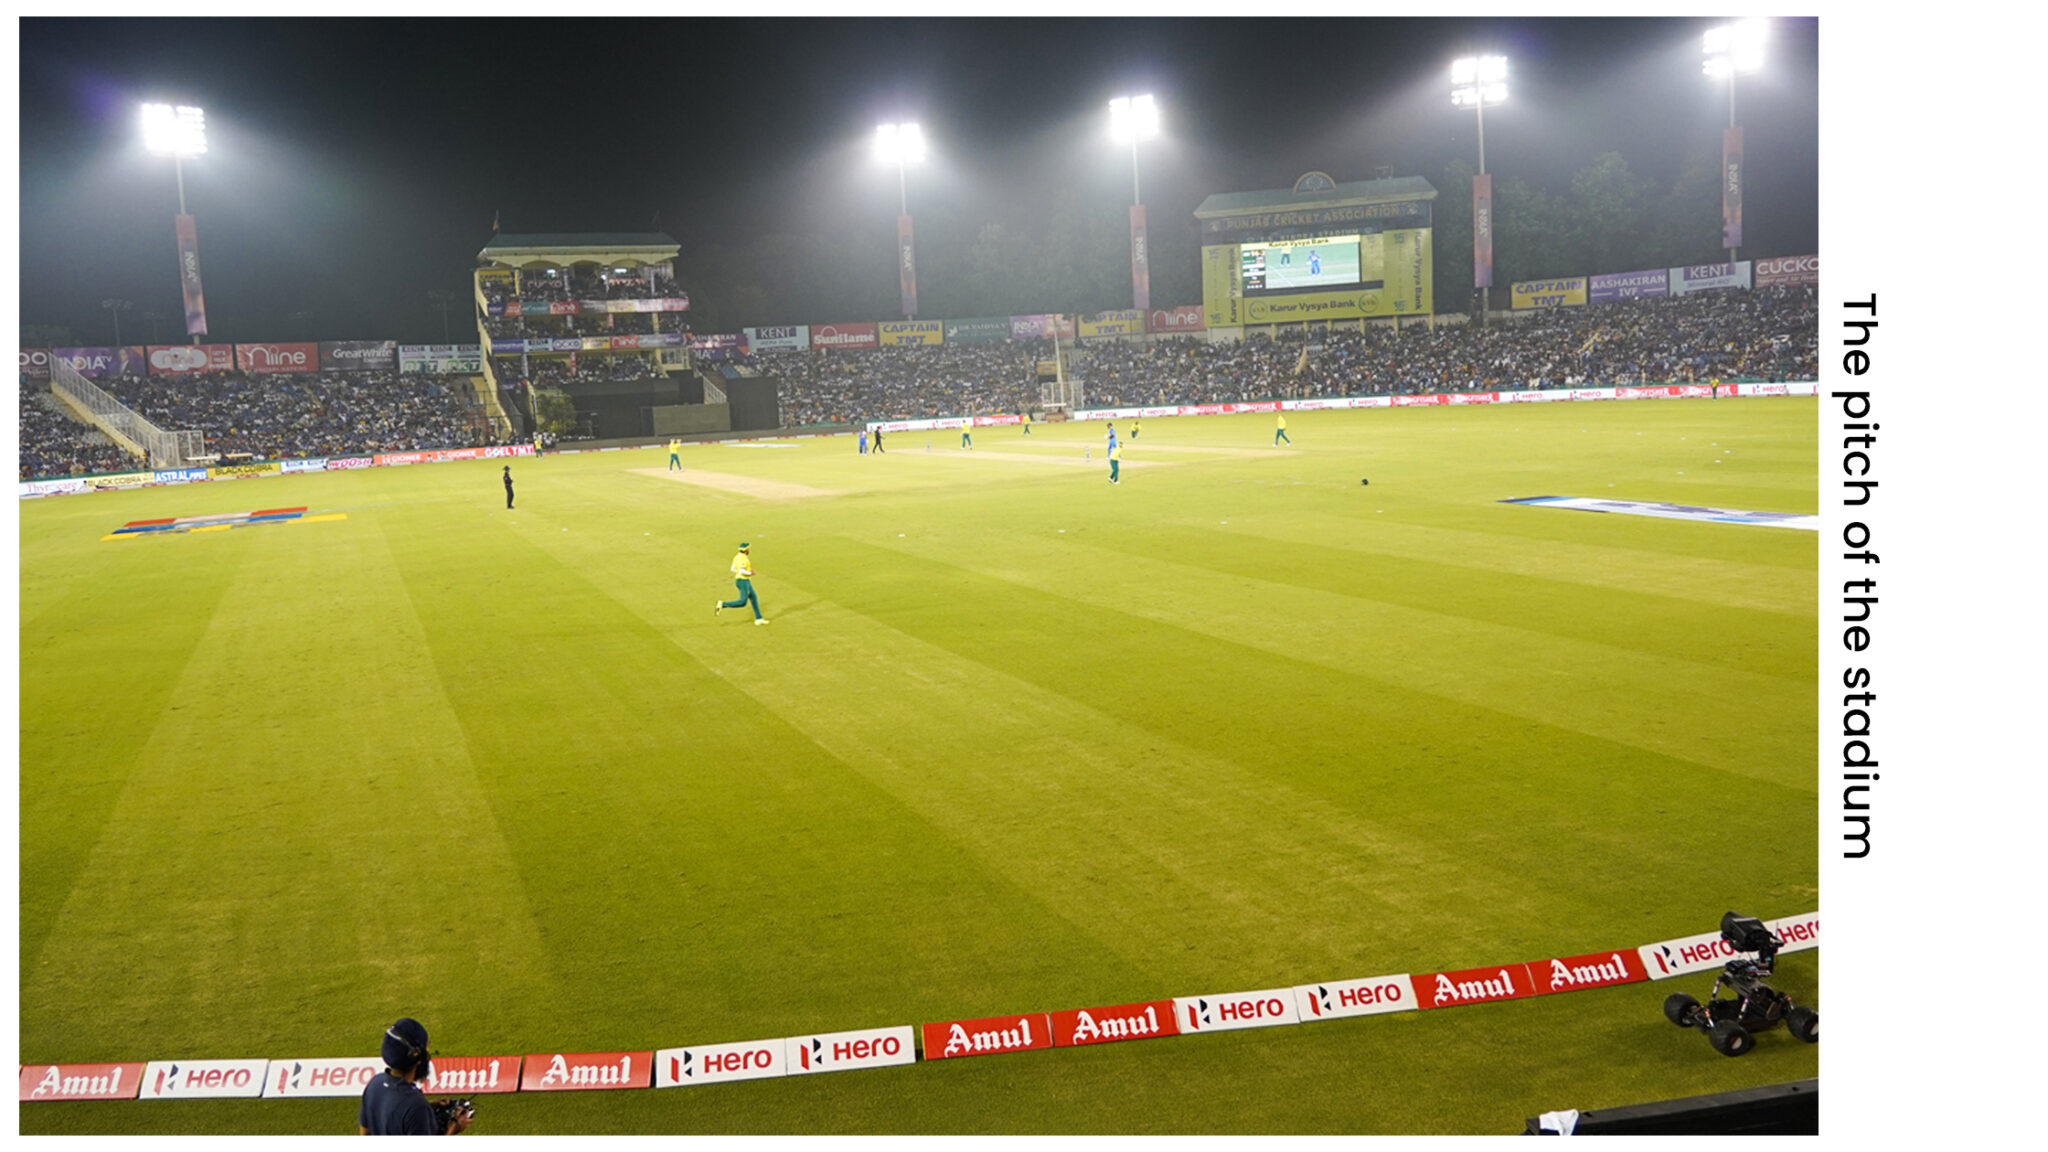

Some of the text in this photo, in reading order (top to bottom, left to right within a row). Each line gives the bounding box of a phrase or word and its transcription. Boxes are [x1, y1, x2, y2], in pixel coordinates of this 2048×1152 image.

[1325, 206, 1399, 222] ASSOCIATION
[1690, 264, 1729, 279] KENT
[1515, 280, 1582, 294] CAPTAIN
[1591, 275, 1666, 290] AASHAKIRAN
[1531, 294, 1566, 305] TMT
[1619, 287, 1638, 297] IVF
[1270, 299, 1355, 313] Karur Vysya Bank
[761, 327, 790, 338] KENT
[883, 323, 939, 333] CAPTAIN
[1096, 324, 1125, 334] TMT
[814, 332, 875, 345] Sunflame
[897, 335, 926, 344] TMT
[332, 348, 392, 359] GreatWhite
[1522, 392, 1543, 400] Hero
[484, 444, 534, 458] GOEL TMT
[155, 471, 188, 482] ASTRAL
[1778, 919, 1818, 945] Her
[1549, 952, 1630, 991] Amul
[1434, 970, 1515, 1005] Amul
[1338, 983, 1402, 1008] Hero
[1219, 998, 1284, 1021] Hero
[1073, 1005, 1160, 1045] Amul
[944, 1018, 1033, 1058] Amul
[833, 1036, 900, 1062] Hero
[704, 1049, 772, 1073] Hero
[309, 1066, 376, 1088] Hero
[416, 1059, 500, 1090] Amul
[540, 1053, 632, 1087] Amul
[31, 1065, 122, 1099] Amul
[185, 1068, 251, 1090] Hero
